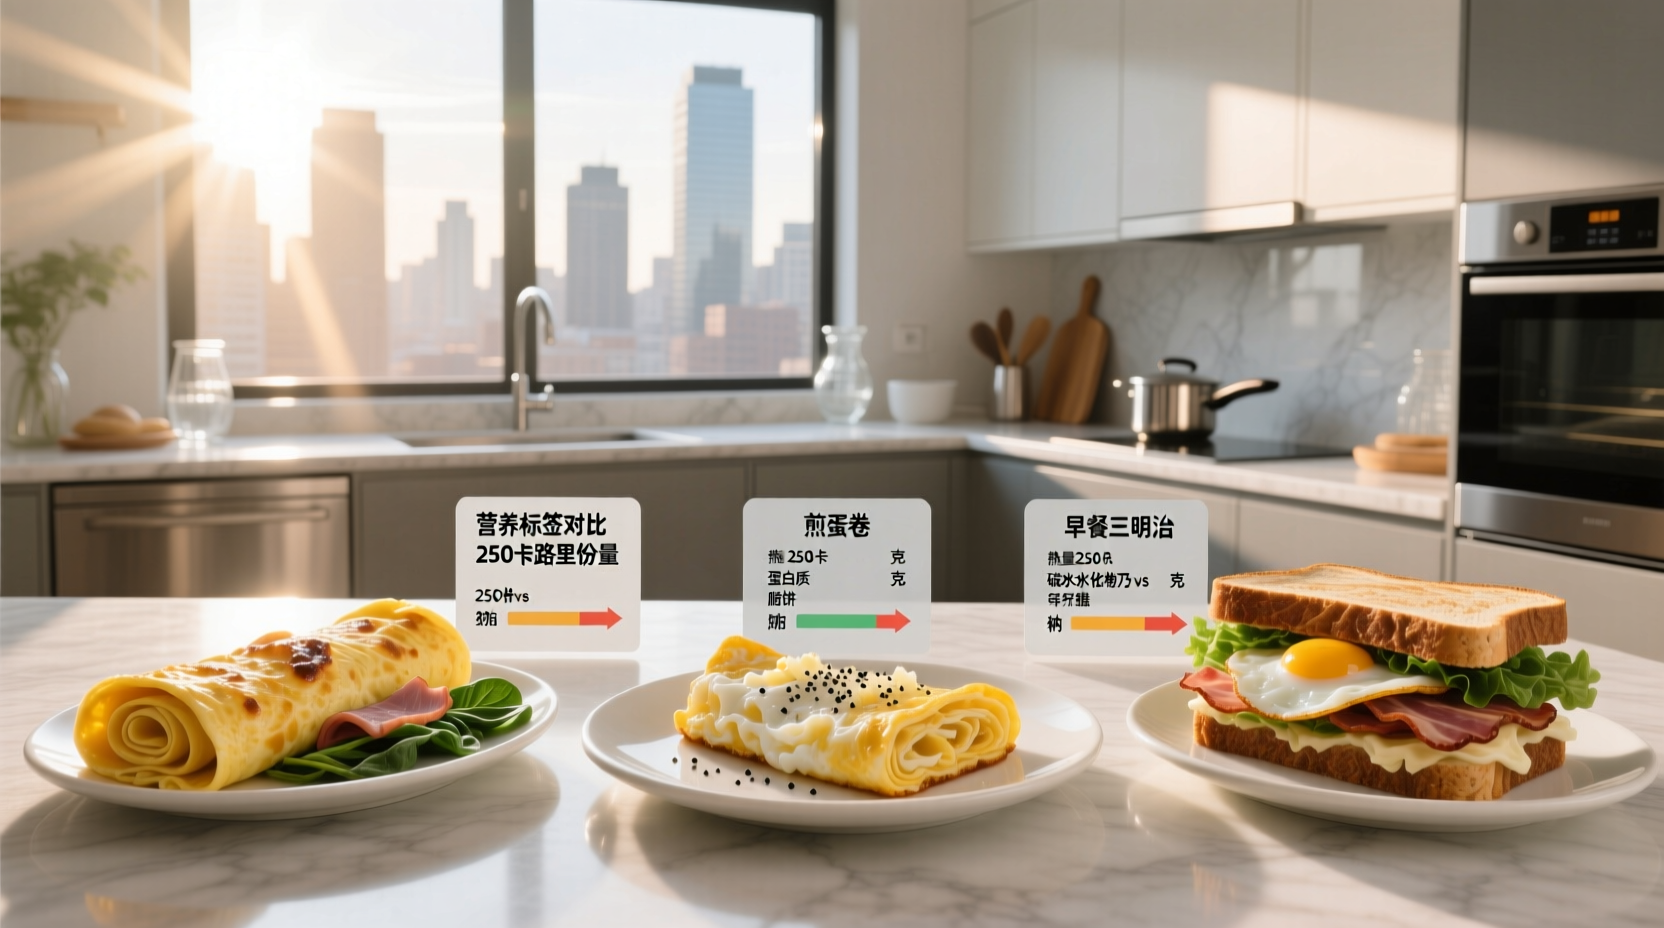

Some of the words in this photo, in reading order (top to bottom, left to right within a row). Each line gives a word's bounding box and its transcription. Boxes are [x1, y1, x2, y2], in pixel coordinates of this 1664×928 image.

[476, 511, 607, 537] 营养标签对比
[803, 512, 871, 538] 煎蛋卷
[1064, 514, 1175, 539] 早餐三明治
[475, 542, 619, 567] 250卡路里份量
[890, 548, 906, 565] 克
[890, 570, 906, 586] 克
[1169, 572, 1185, 589] 克
